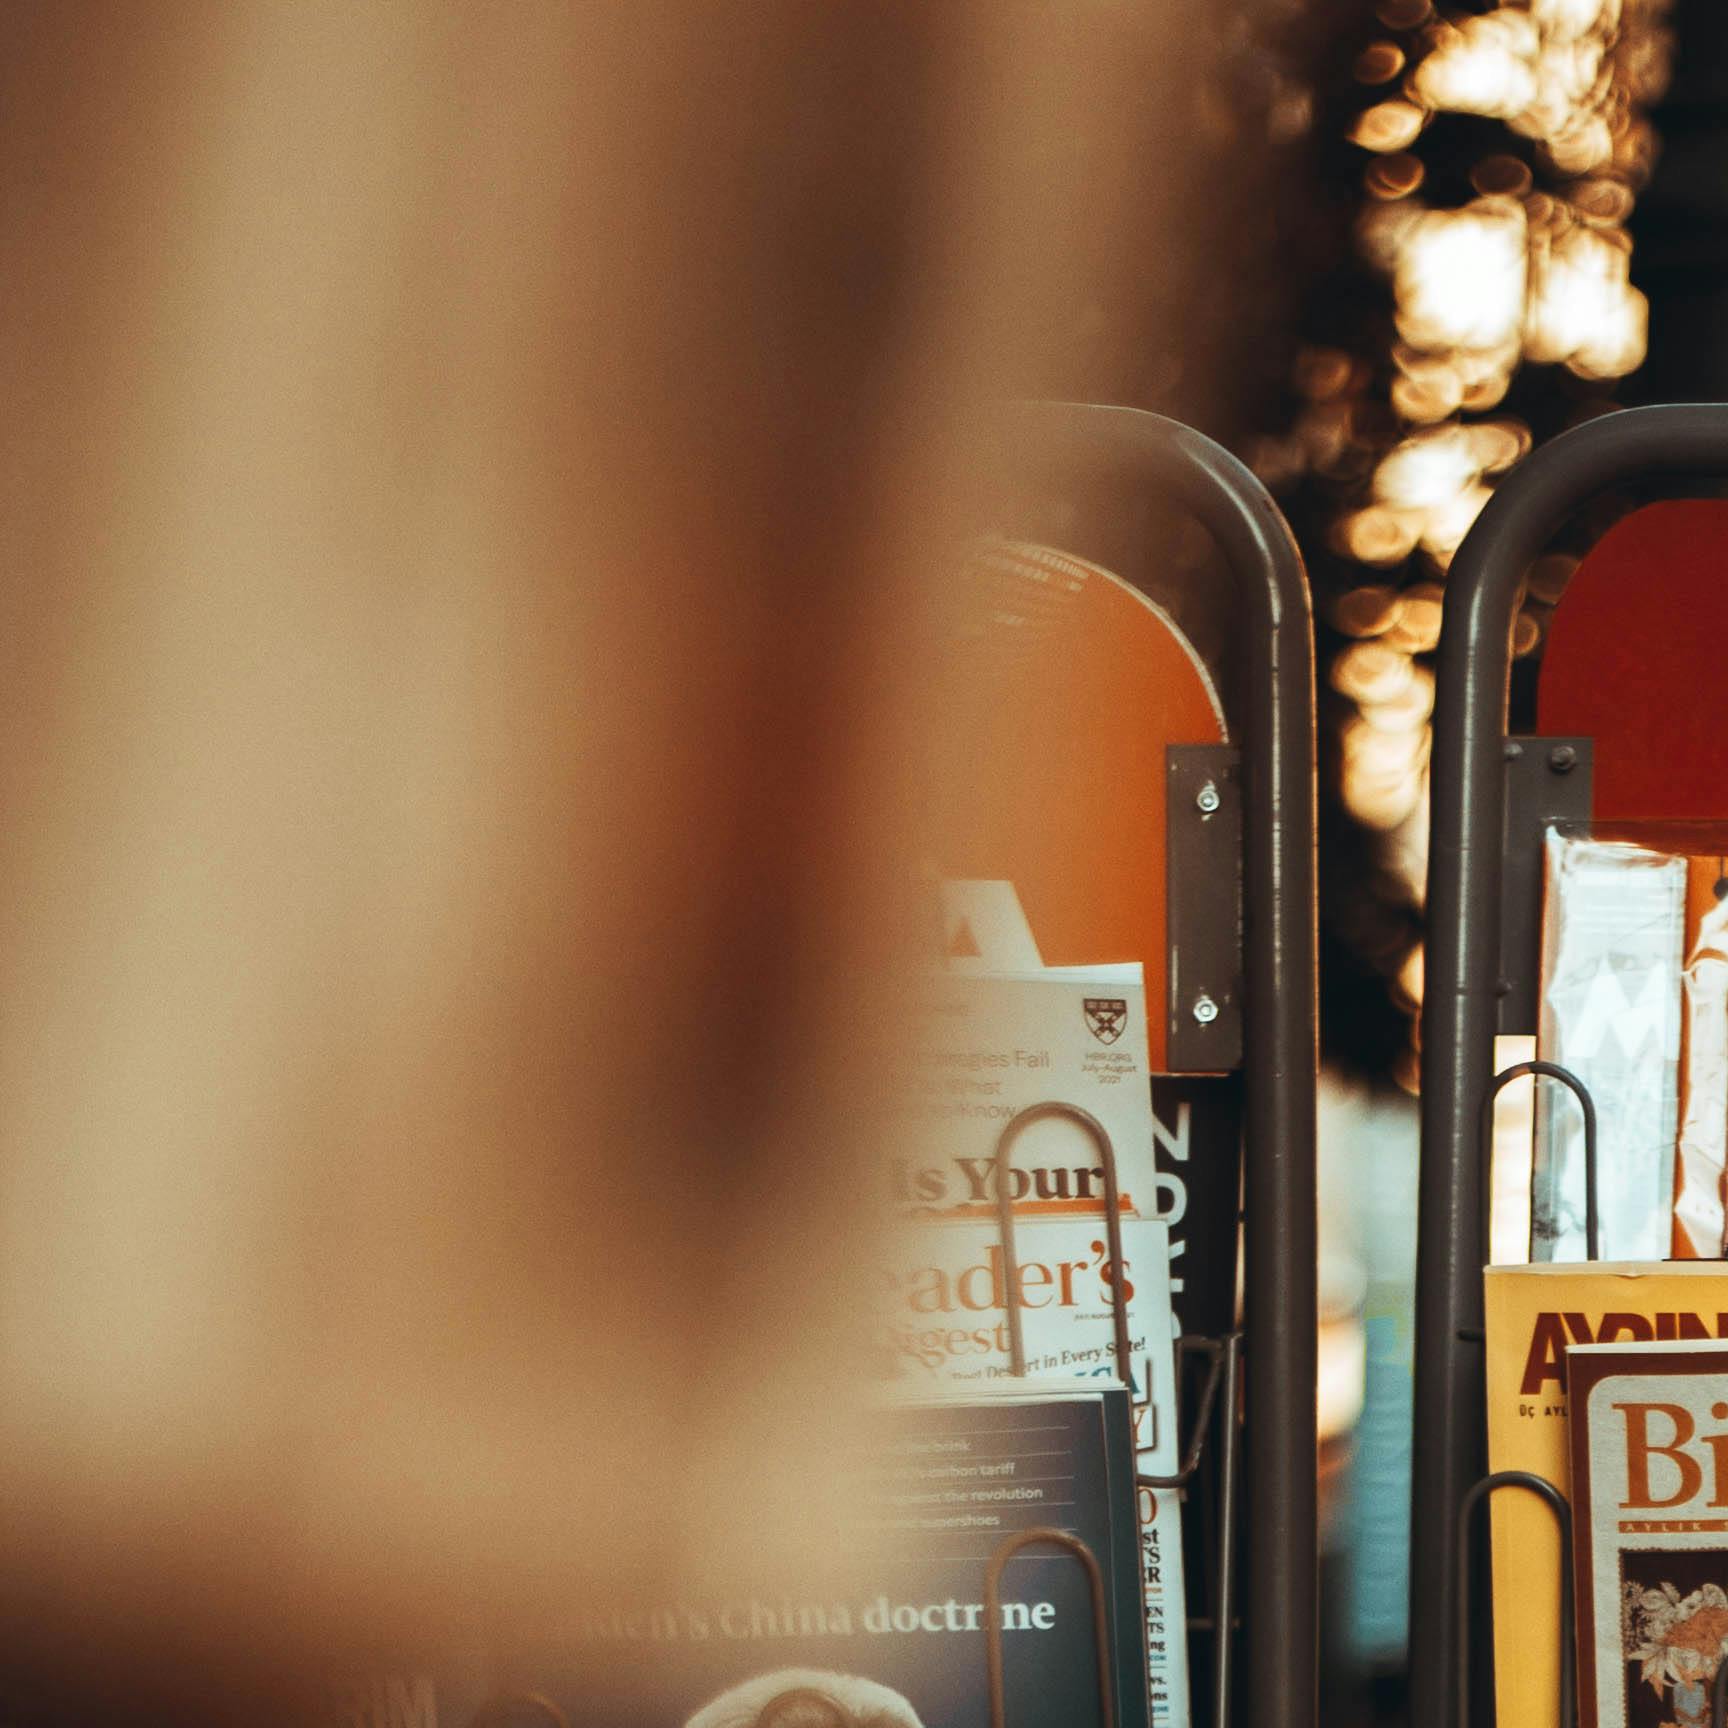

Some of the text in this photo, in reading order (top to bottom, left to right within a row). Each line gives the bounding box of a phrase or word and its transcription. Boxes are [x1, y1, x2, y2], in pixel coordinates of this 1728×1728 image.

[1061, 1346, 1102, 1368] Every
[980, 1462, 1016, 1476] tariff
[971, 1487, 1043, 1500] revolution
[863, 1591, 1056, 1634] doctrne
